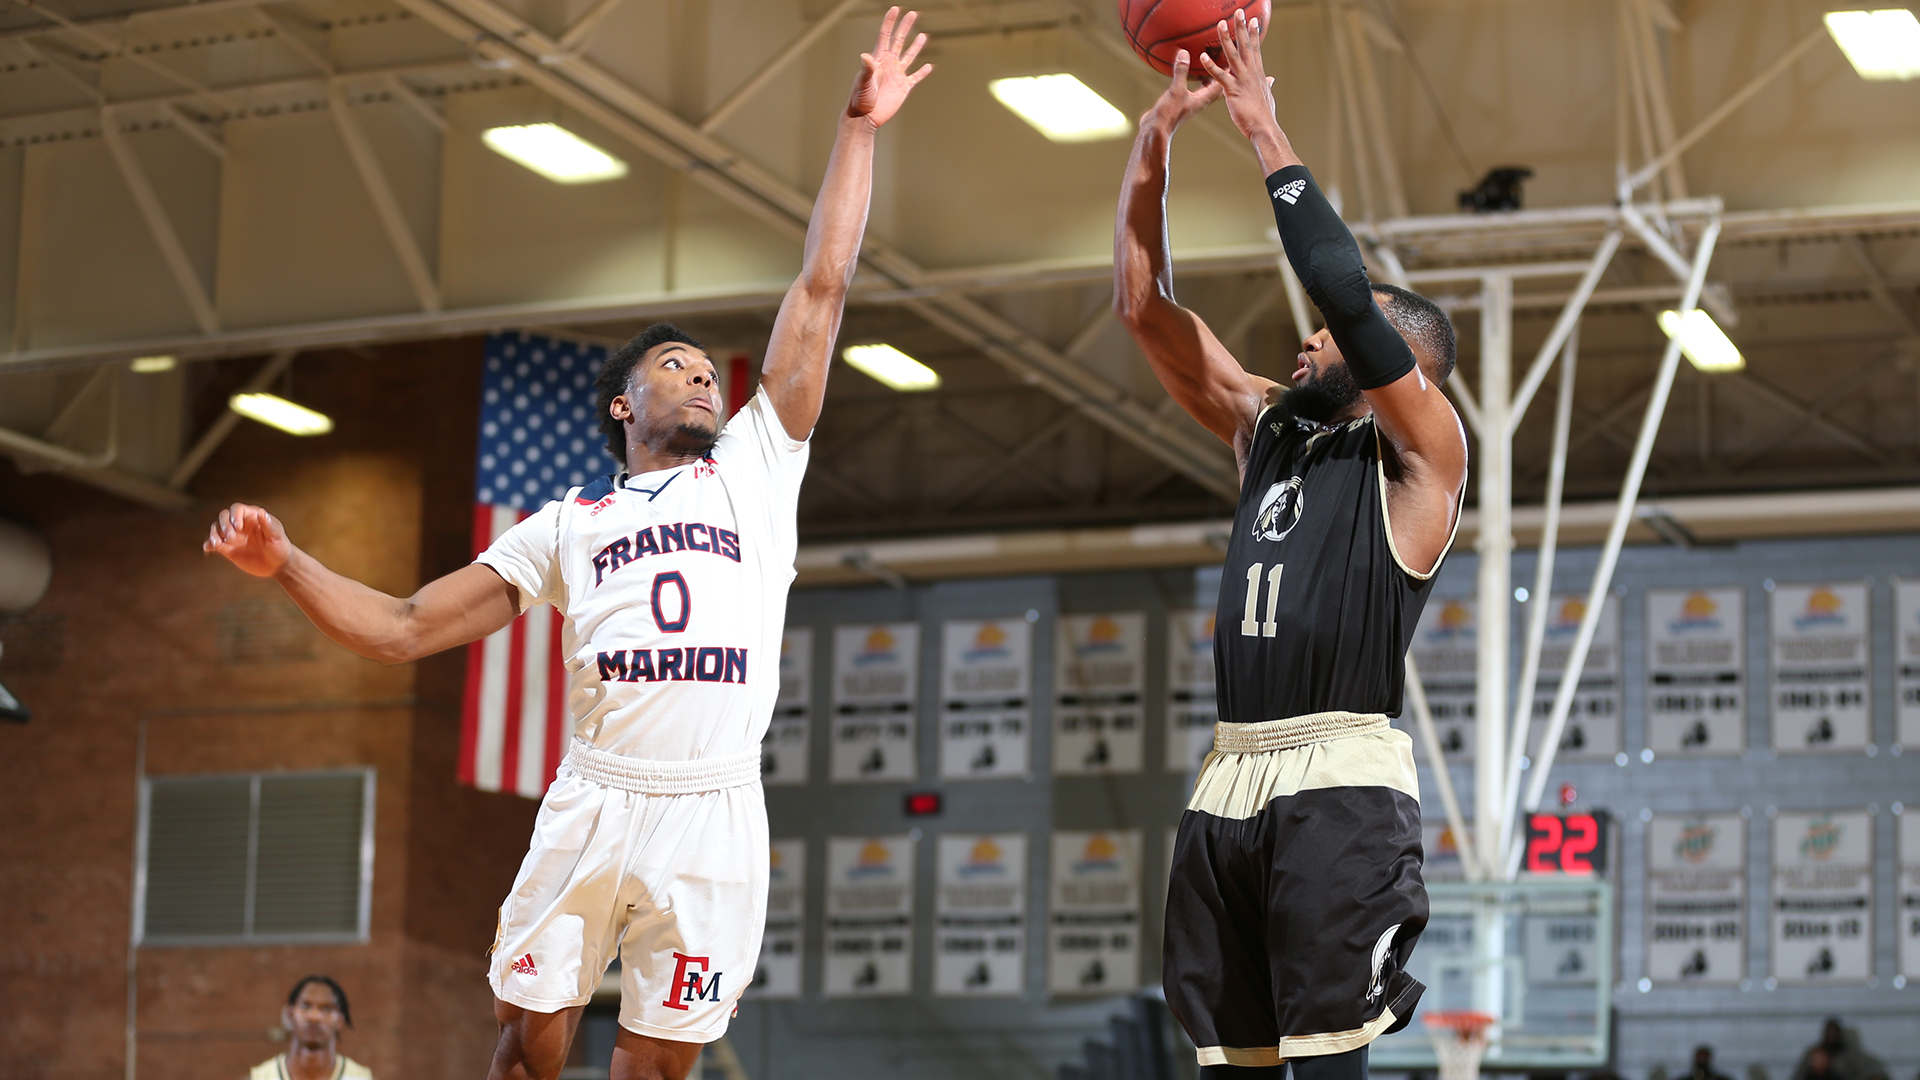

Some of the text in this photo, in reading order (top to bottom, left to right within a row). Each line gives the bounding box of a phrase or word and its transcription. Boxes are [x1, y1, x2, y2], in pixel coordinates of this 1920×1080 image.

[1273, 179, 1306, 198] adidas
[592, 522, 741, 589] FRANCIS
[650, 570, 691, 634] 0
[1241, 562, 1284, 638] 11
[597, 647, 748, 684] MARION
[1527, 812, 1598, 877] 22
[511, 961, 538, 977] adidas
